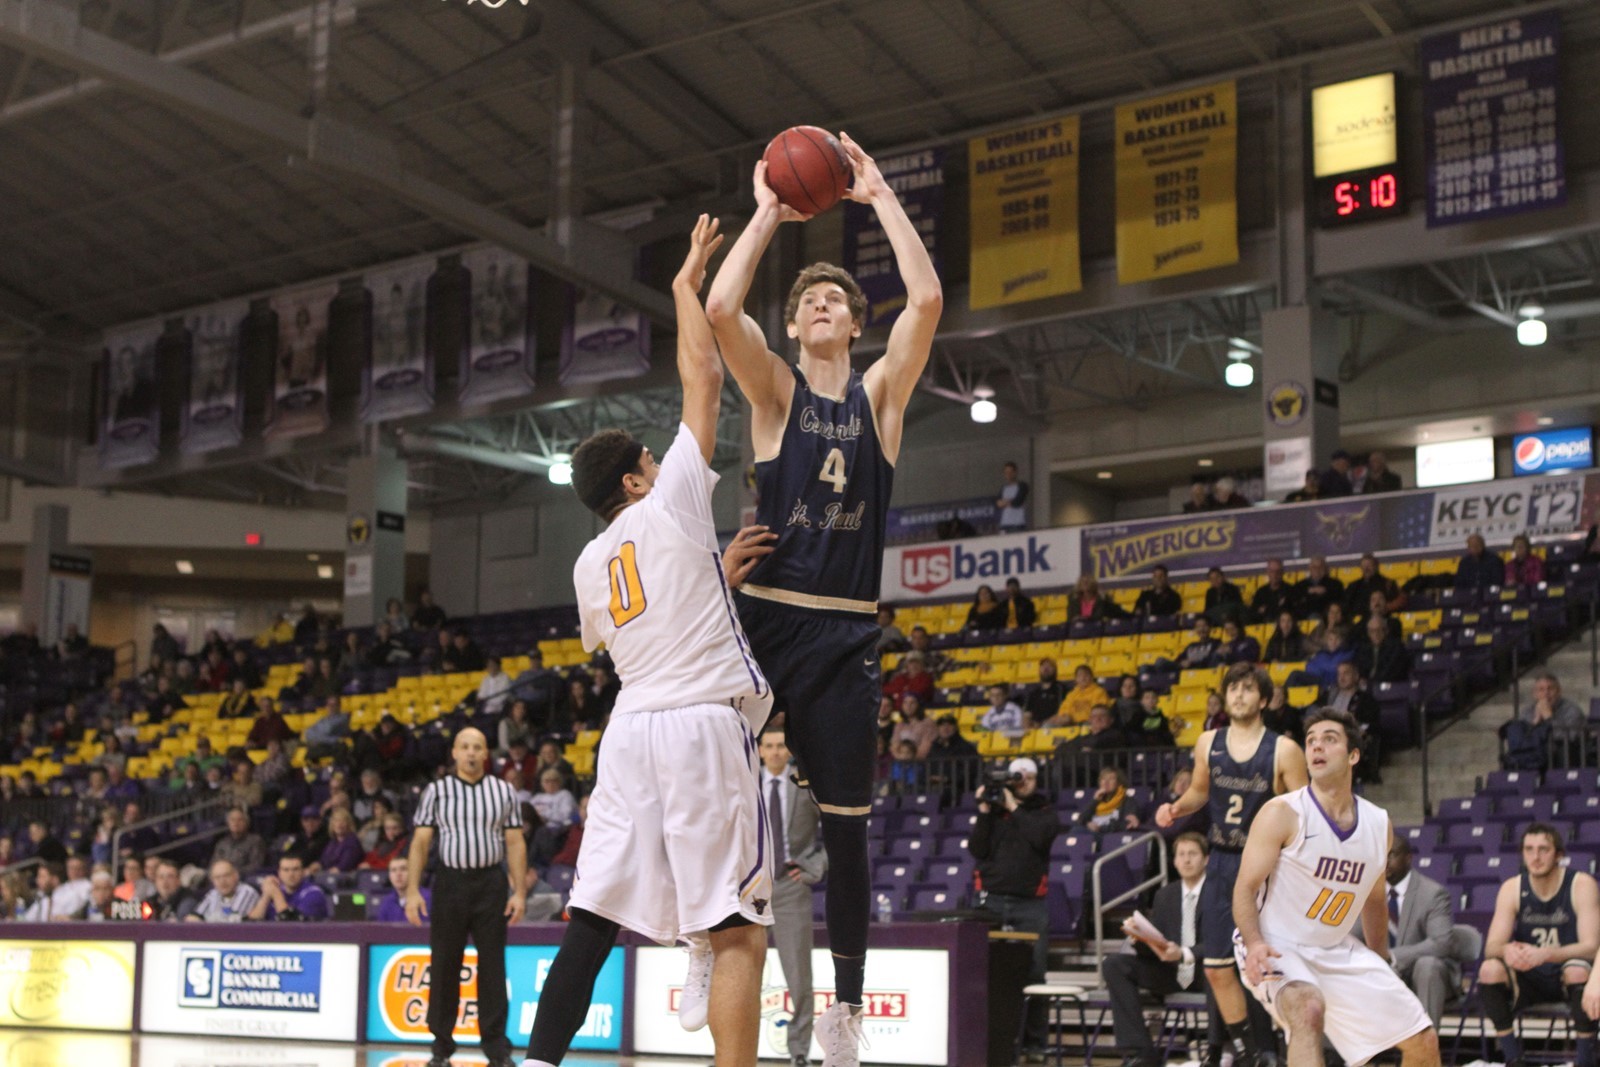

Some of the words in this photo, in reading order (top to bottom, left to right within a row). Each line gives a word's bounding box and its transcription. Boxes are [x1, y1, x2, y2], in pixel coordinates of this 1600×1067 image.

[1429, 37, 1556, 80] BASKETBALL
[1135, 93, 1215, 122] WOMEN'S
[987, 123, 1062, 152] WOMEN'S
[1124, 112, 1227, 146] BASKETBALL
[976, 141, 1073, 174] BASKETBALL
[887, 168, 943, 193] ETBALL
[1335, 174, 1396, 216] 5:10
[1546, 437, 1590, 459] pepsi
[819, 448, 847, 493] 4
[819, 501, 865, 530] Paul
[1438, 492, 1522, 523] KEYC
[1533, 492, 1578, 526] 12
[1094, 522, 1231, 578] MAVERICKS
[608, 541, 647, 629] 0
[1225, 794, 1243, 824] 2
[1314, 857, 1365, 884] MSU
[1306, 887, 1356, 927] 10
[1531, 927, 1561, 948] 34
[223, 953, 304, 972] COLDWELL
[398, 963, 477, 989] HAP
[222, 971, 281, 989] BANKER
[221, 988, 319, 1008] COMMERCIAL
